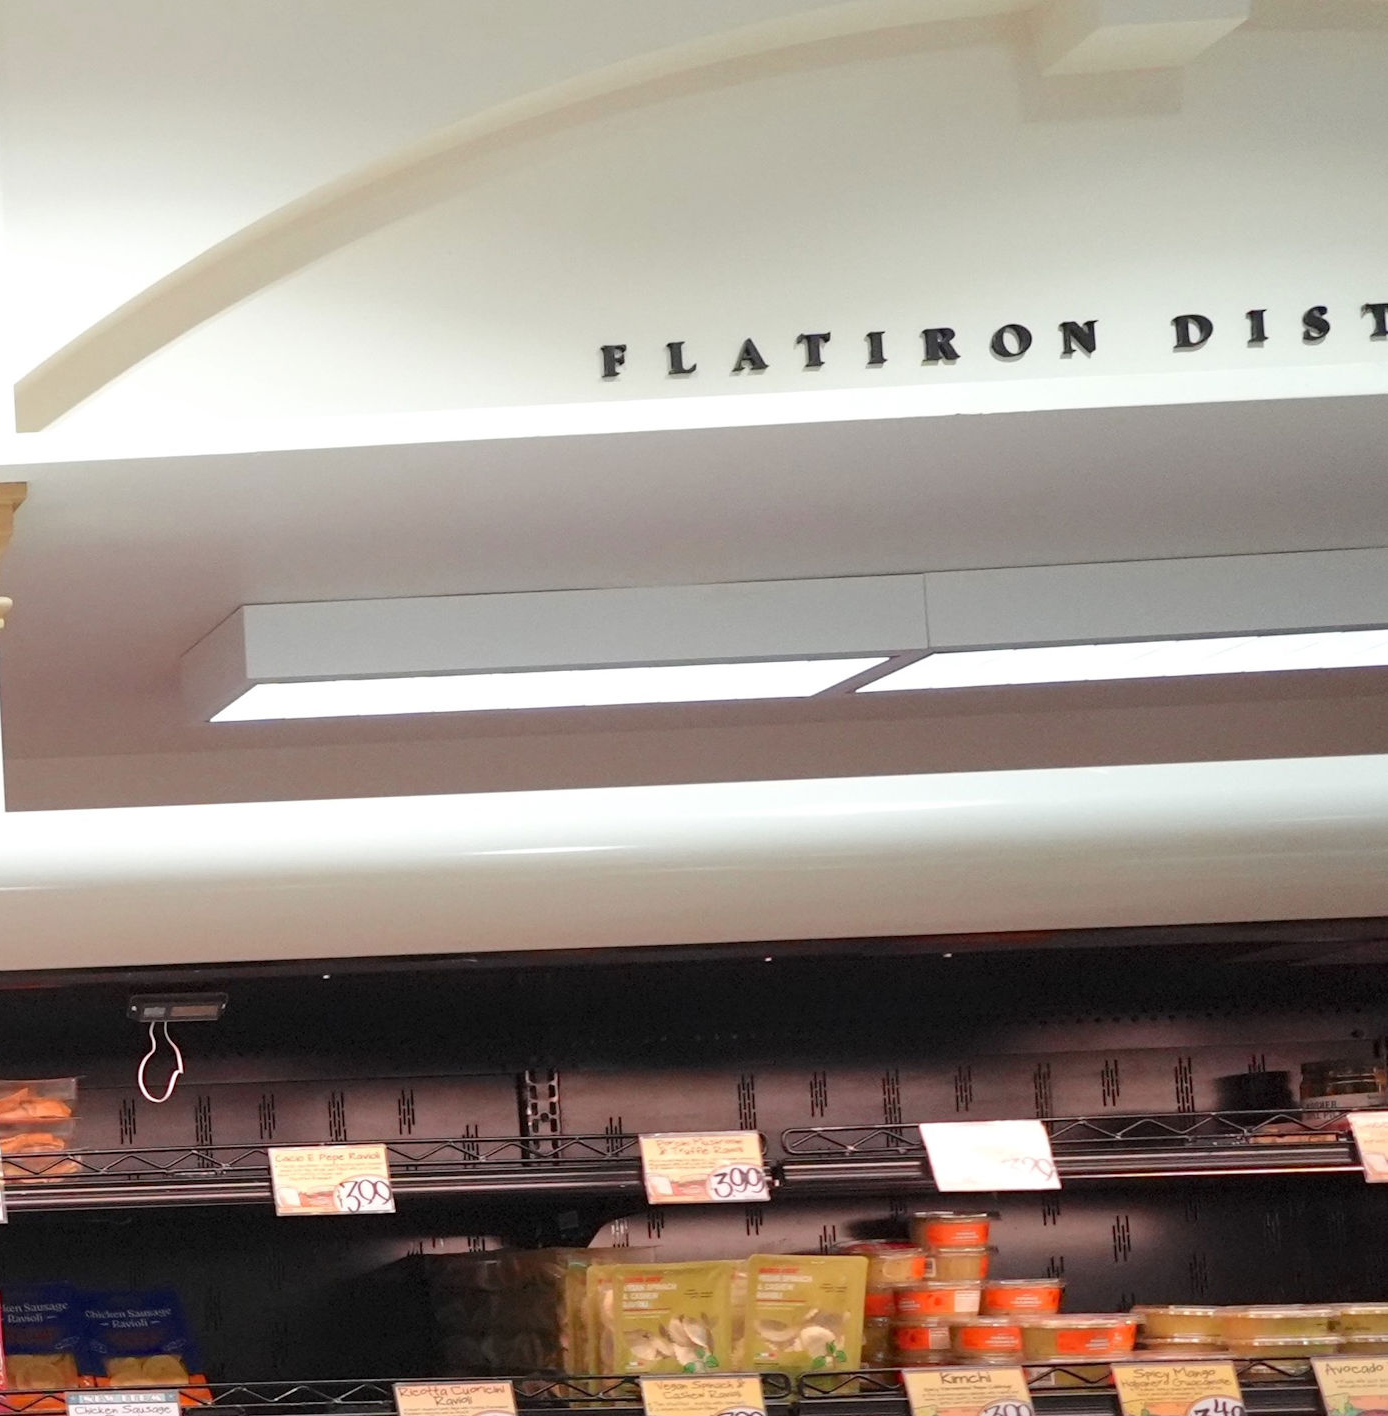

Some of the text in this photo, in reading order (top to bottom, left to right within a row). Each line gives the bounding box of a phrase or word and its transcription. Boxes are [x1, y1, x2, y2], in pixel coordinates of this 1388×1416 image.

[600, 302, 1388, 378] FLATIRON DIST
[1132, 1366, 1217, 1381] Spicy Mango
[1325, 1362, 1385, 1376] Avocado
[939, 1370, 992, 1385] Kimchi
[399, 1387, 448, 1398] Ricotta
[74, 1404, 172, 1415] Chicken Sausage
